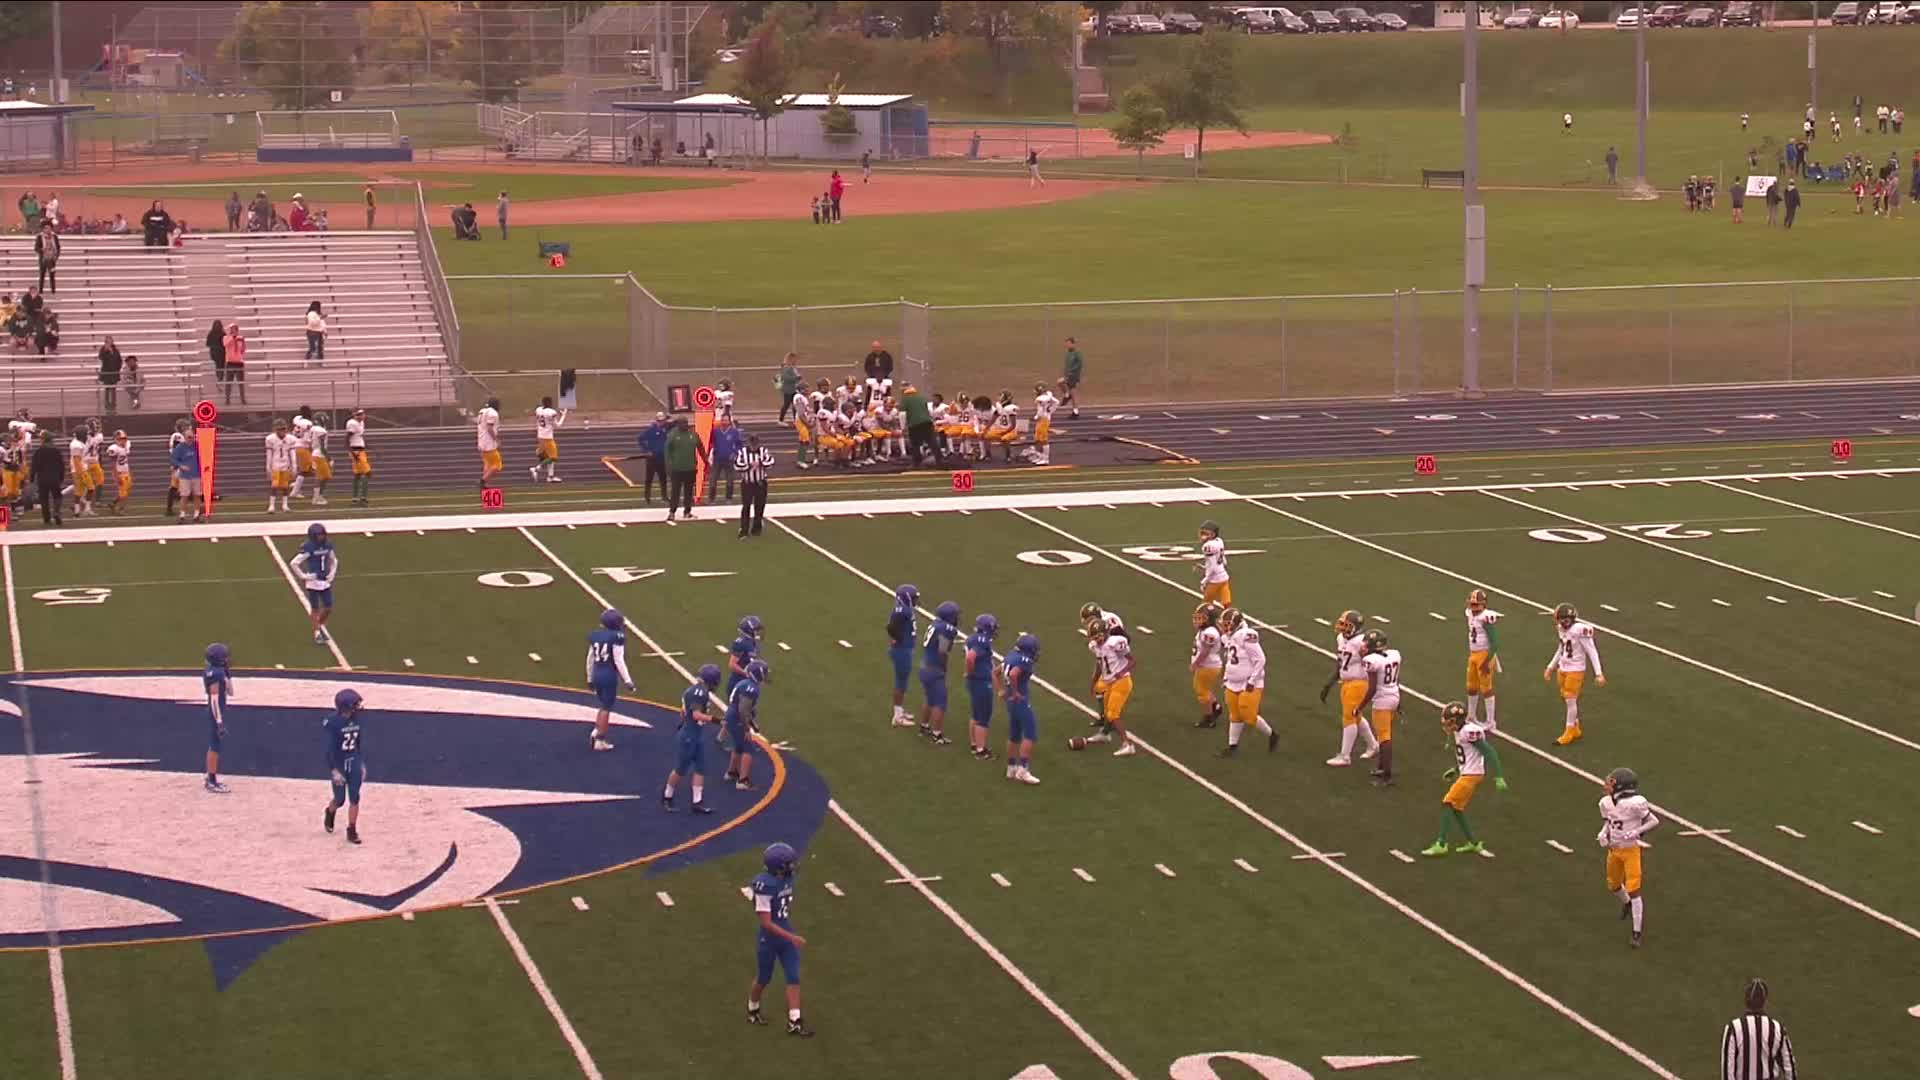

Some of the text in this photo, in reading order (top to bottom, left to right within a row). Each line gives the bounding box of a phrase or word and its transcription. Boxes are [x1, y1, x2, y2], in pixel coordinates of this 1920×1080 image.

[953, 473, 972, 489] 30
[483, 490, 502, 507] 40
[1383, 661, 1399, 685] 87
[342, 732, 359, 751] 22
